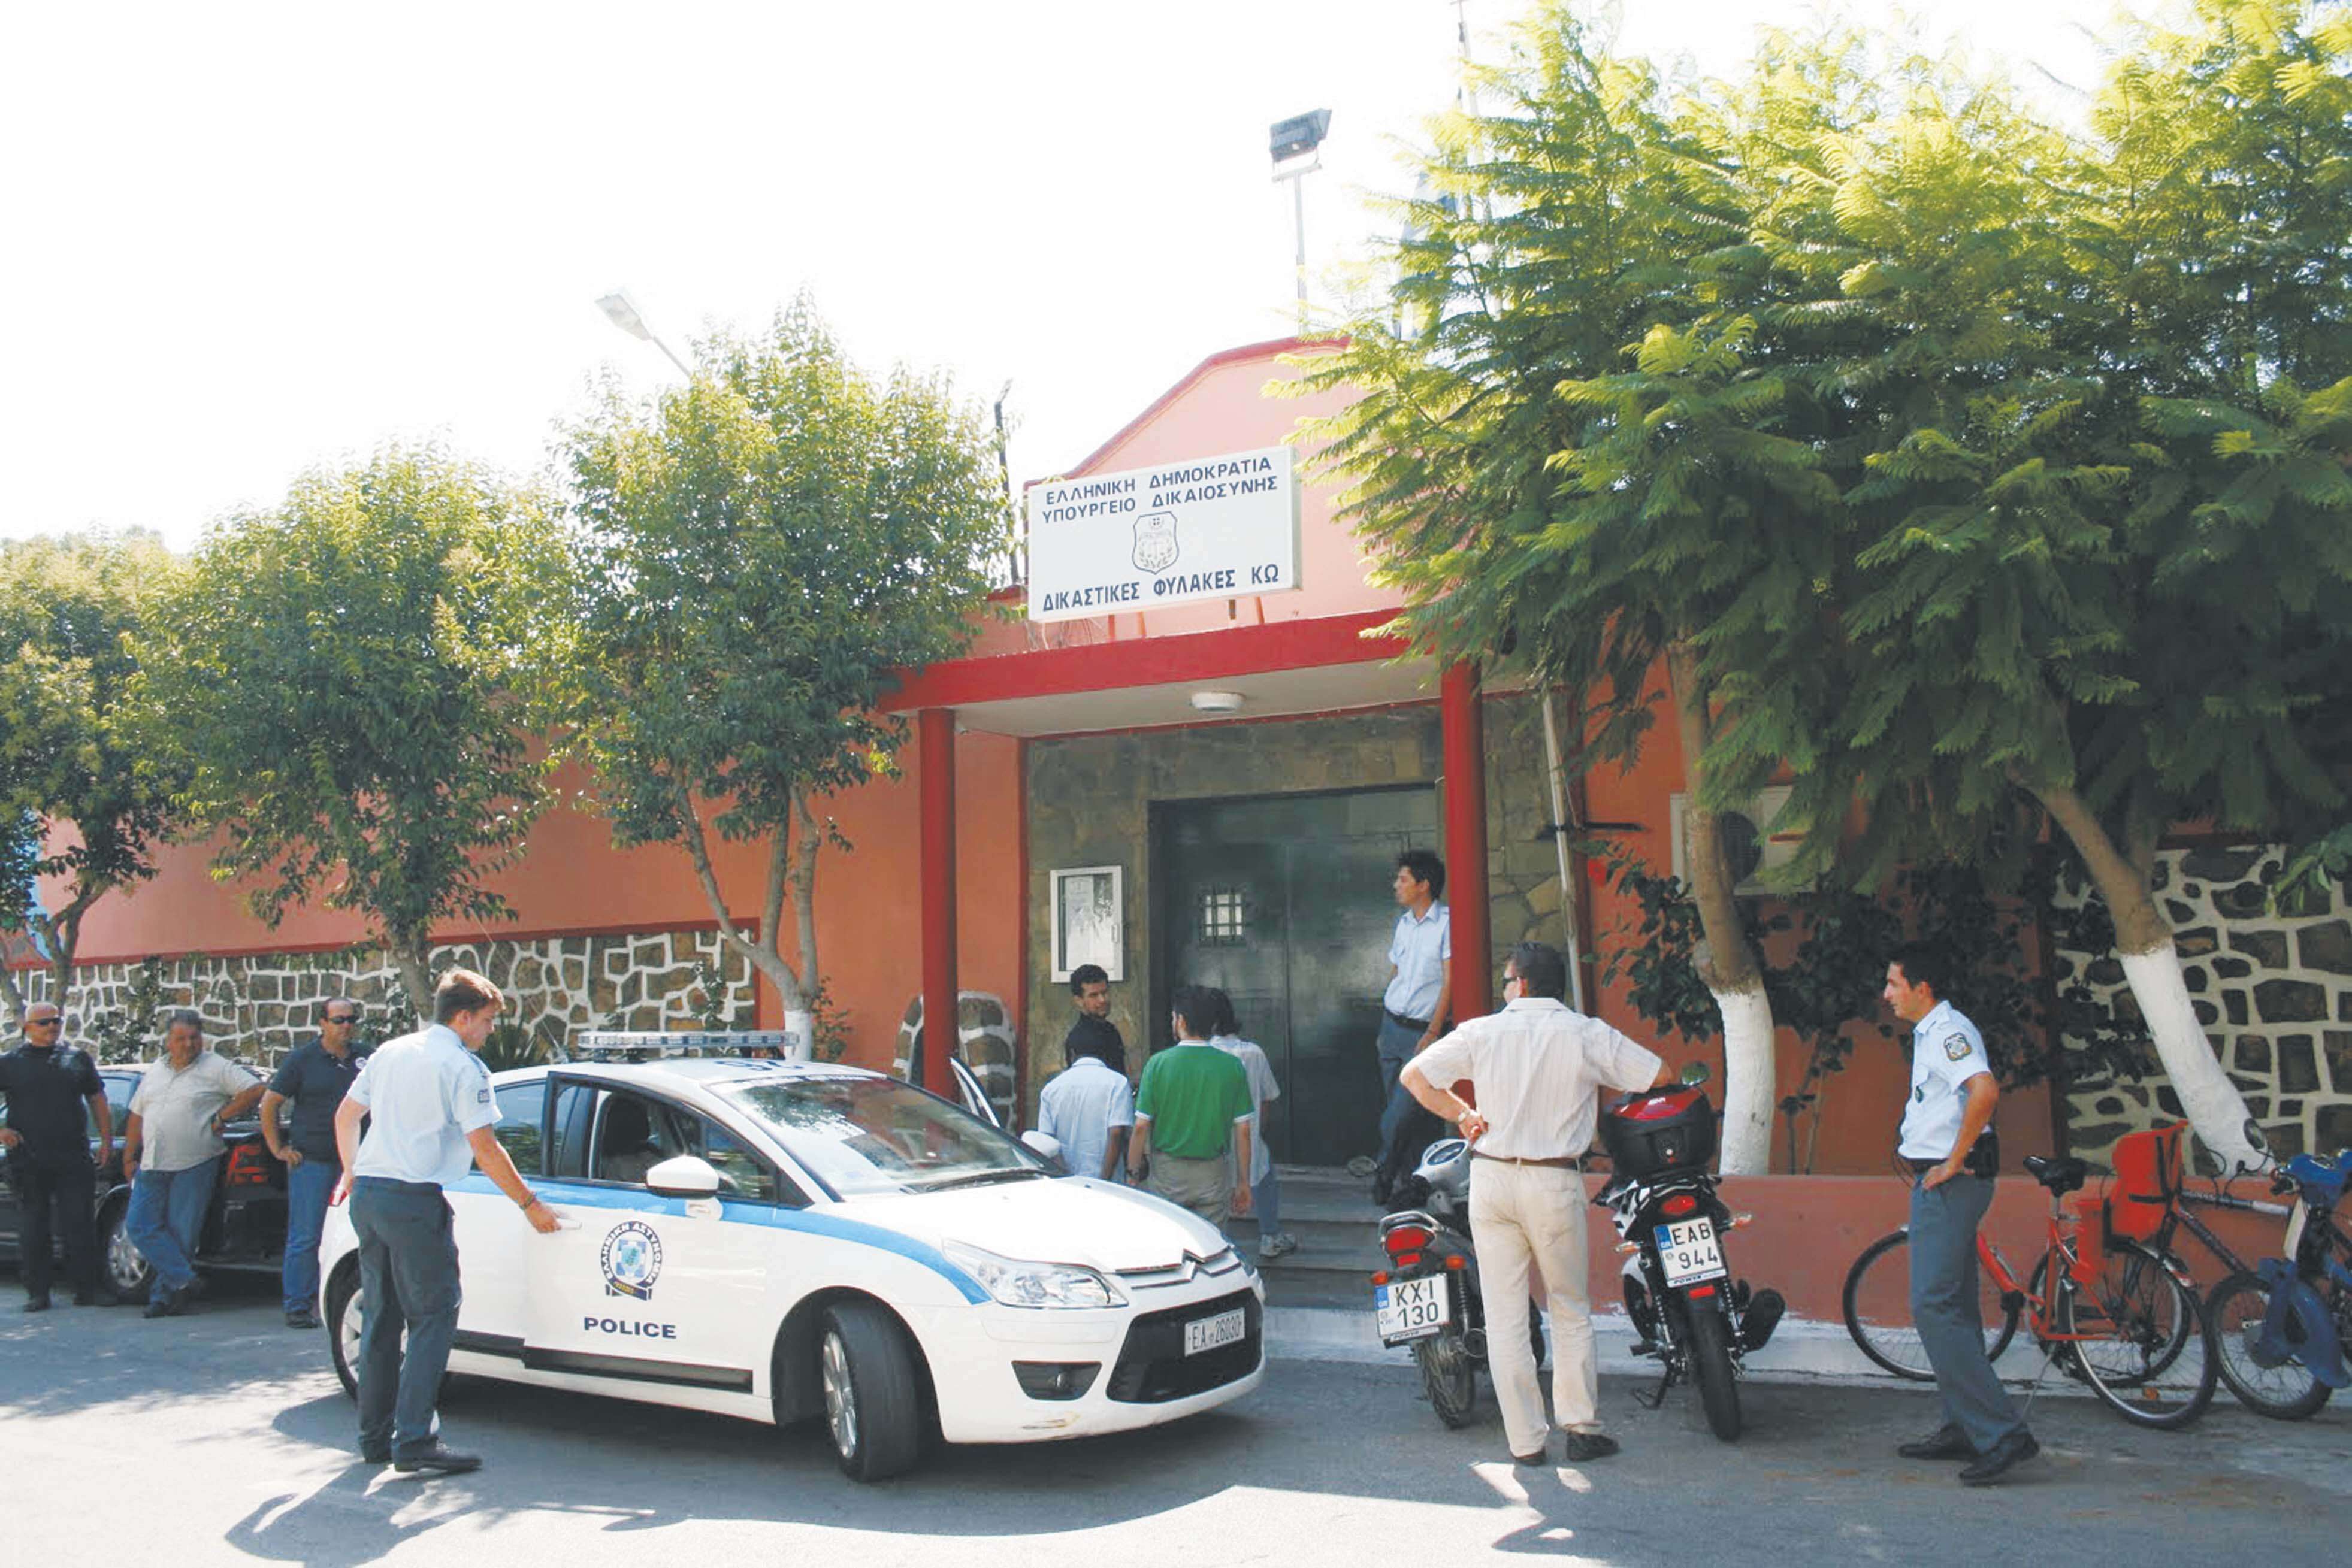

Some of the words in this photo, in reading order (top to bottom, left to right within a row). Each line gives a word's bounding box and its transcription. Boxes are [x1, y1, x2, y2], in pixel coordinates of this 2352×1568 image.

[1042, 498, 1136, 523] ΥΠΟΥΡΓΕΙΟ
[1152, 476, 1278, 508] ΔΙΚΑΙΟΣΥΝΗΣ
[1046, 478, 1135, 505] ΕΛΛΗΝΙΚΗ
[1149, 457, 1272, 489] ΔΗΜΟΚΡΑΤΙΑ
[1042, 582, 1141, 612] ΔΙΚΑΣΤΙΚΕΣ
[1153, 569, 1236, 596] ΦΥΛΑΚΕΣ
[1251, 564, 1279, 585] ΚΩ
[1678, 1246, 1718, 1269] 944
[584, 1316, 676, 1339] POLICE
[1397, 1301, 1438, 1328] 130
